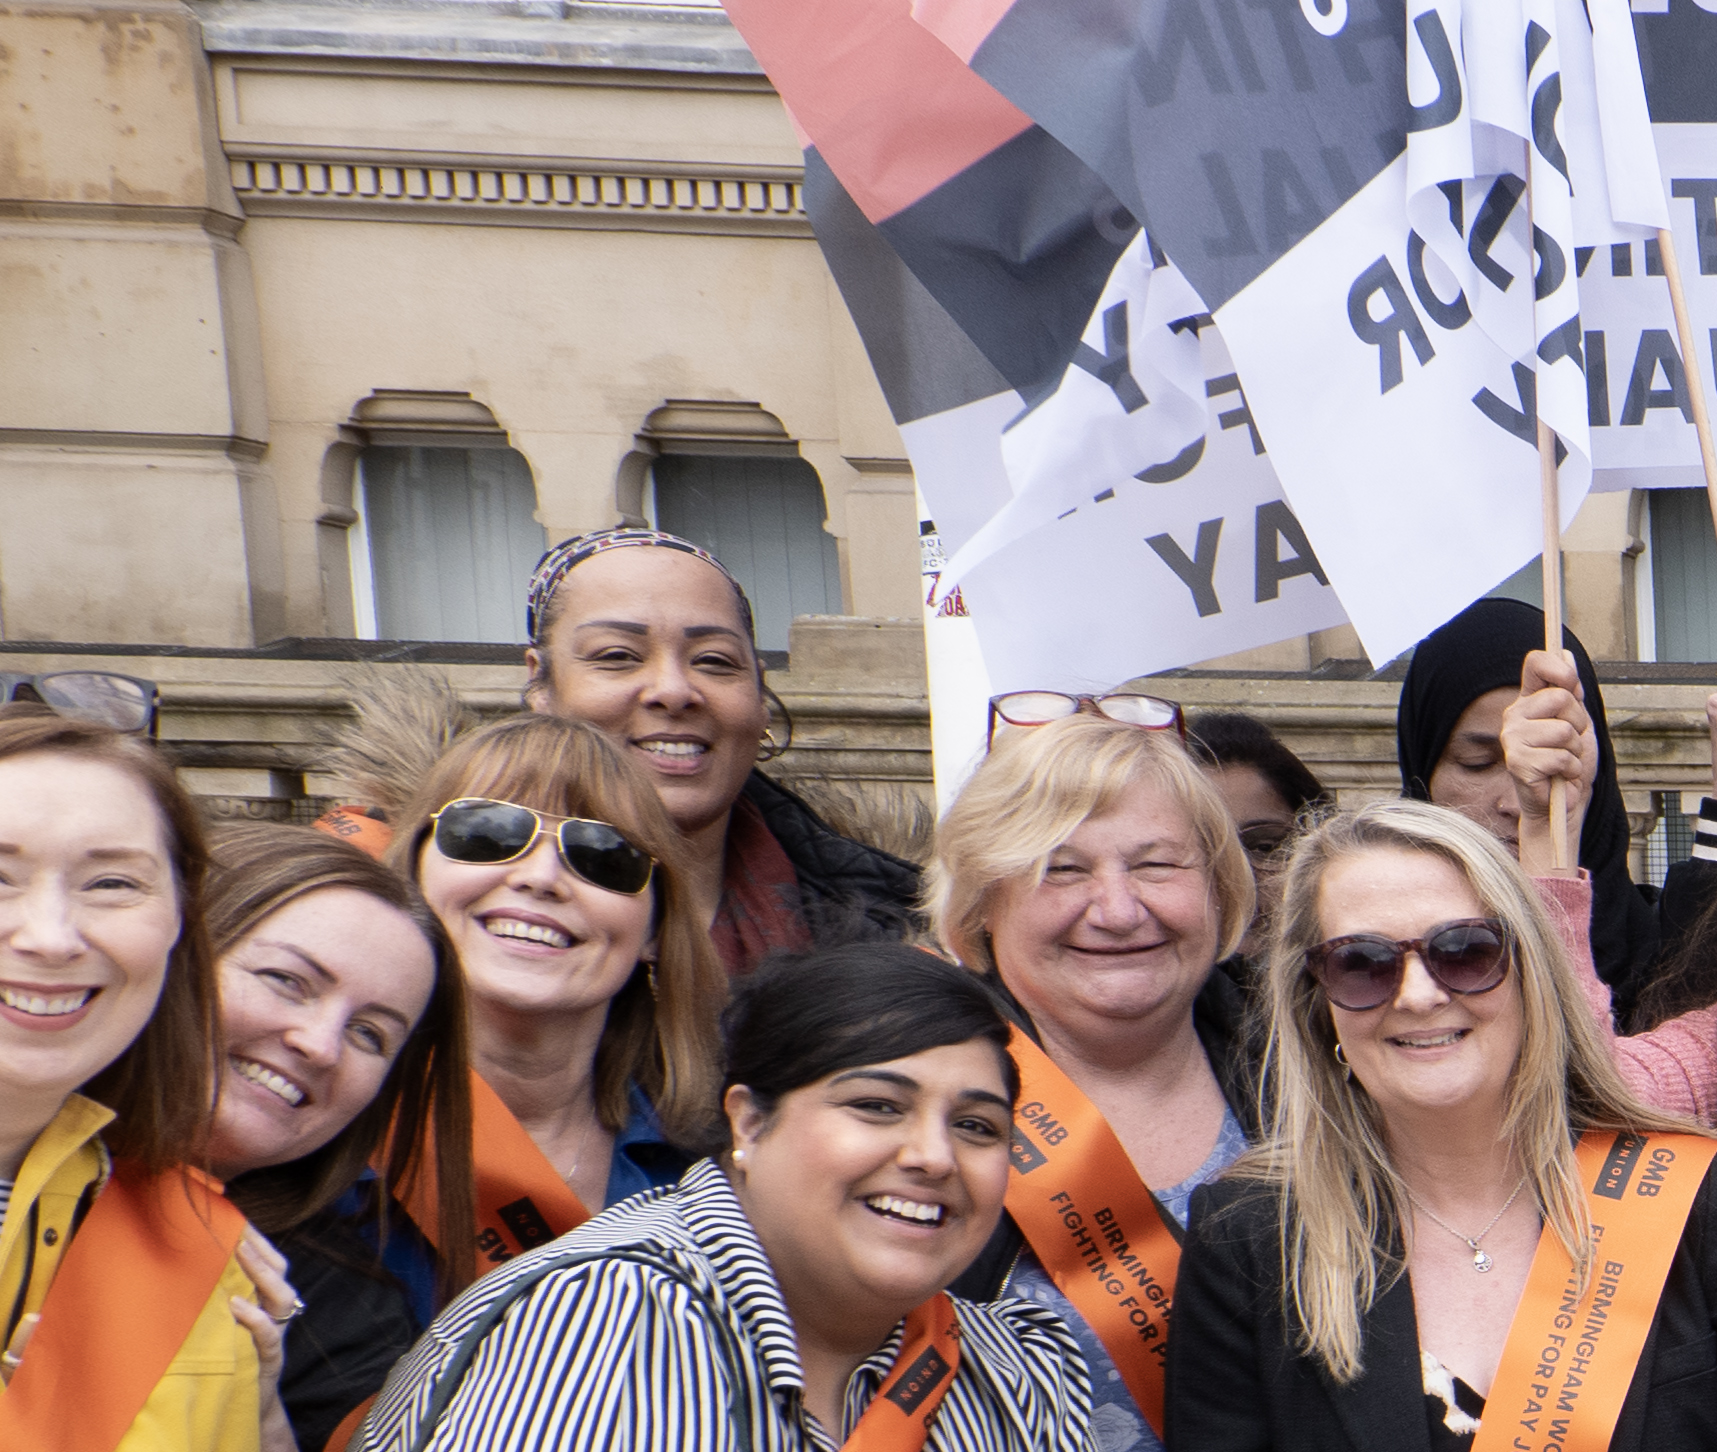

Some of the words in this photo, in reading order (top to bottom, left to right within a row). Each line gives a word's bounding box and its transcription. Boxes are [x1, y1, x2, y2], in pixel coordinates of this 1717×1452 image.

[1020, 1101, 1069, 1146] GMB
[1606, 1140, 1635, 1189] UNION
[1637, 1147, 1676, 1198] GMB
[1050, 1191, 1125, 1296] FIGHTING
[1119, 1296, 1159, 1343] FOR
[1535, 1333, 1565, 1379] FOR
[1556, 1260, 1624, 1413] BIRMINGHAM
[900, 1359, 939, 1401] UNION
[1520, 1383, 1549, 1433] PAY
